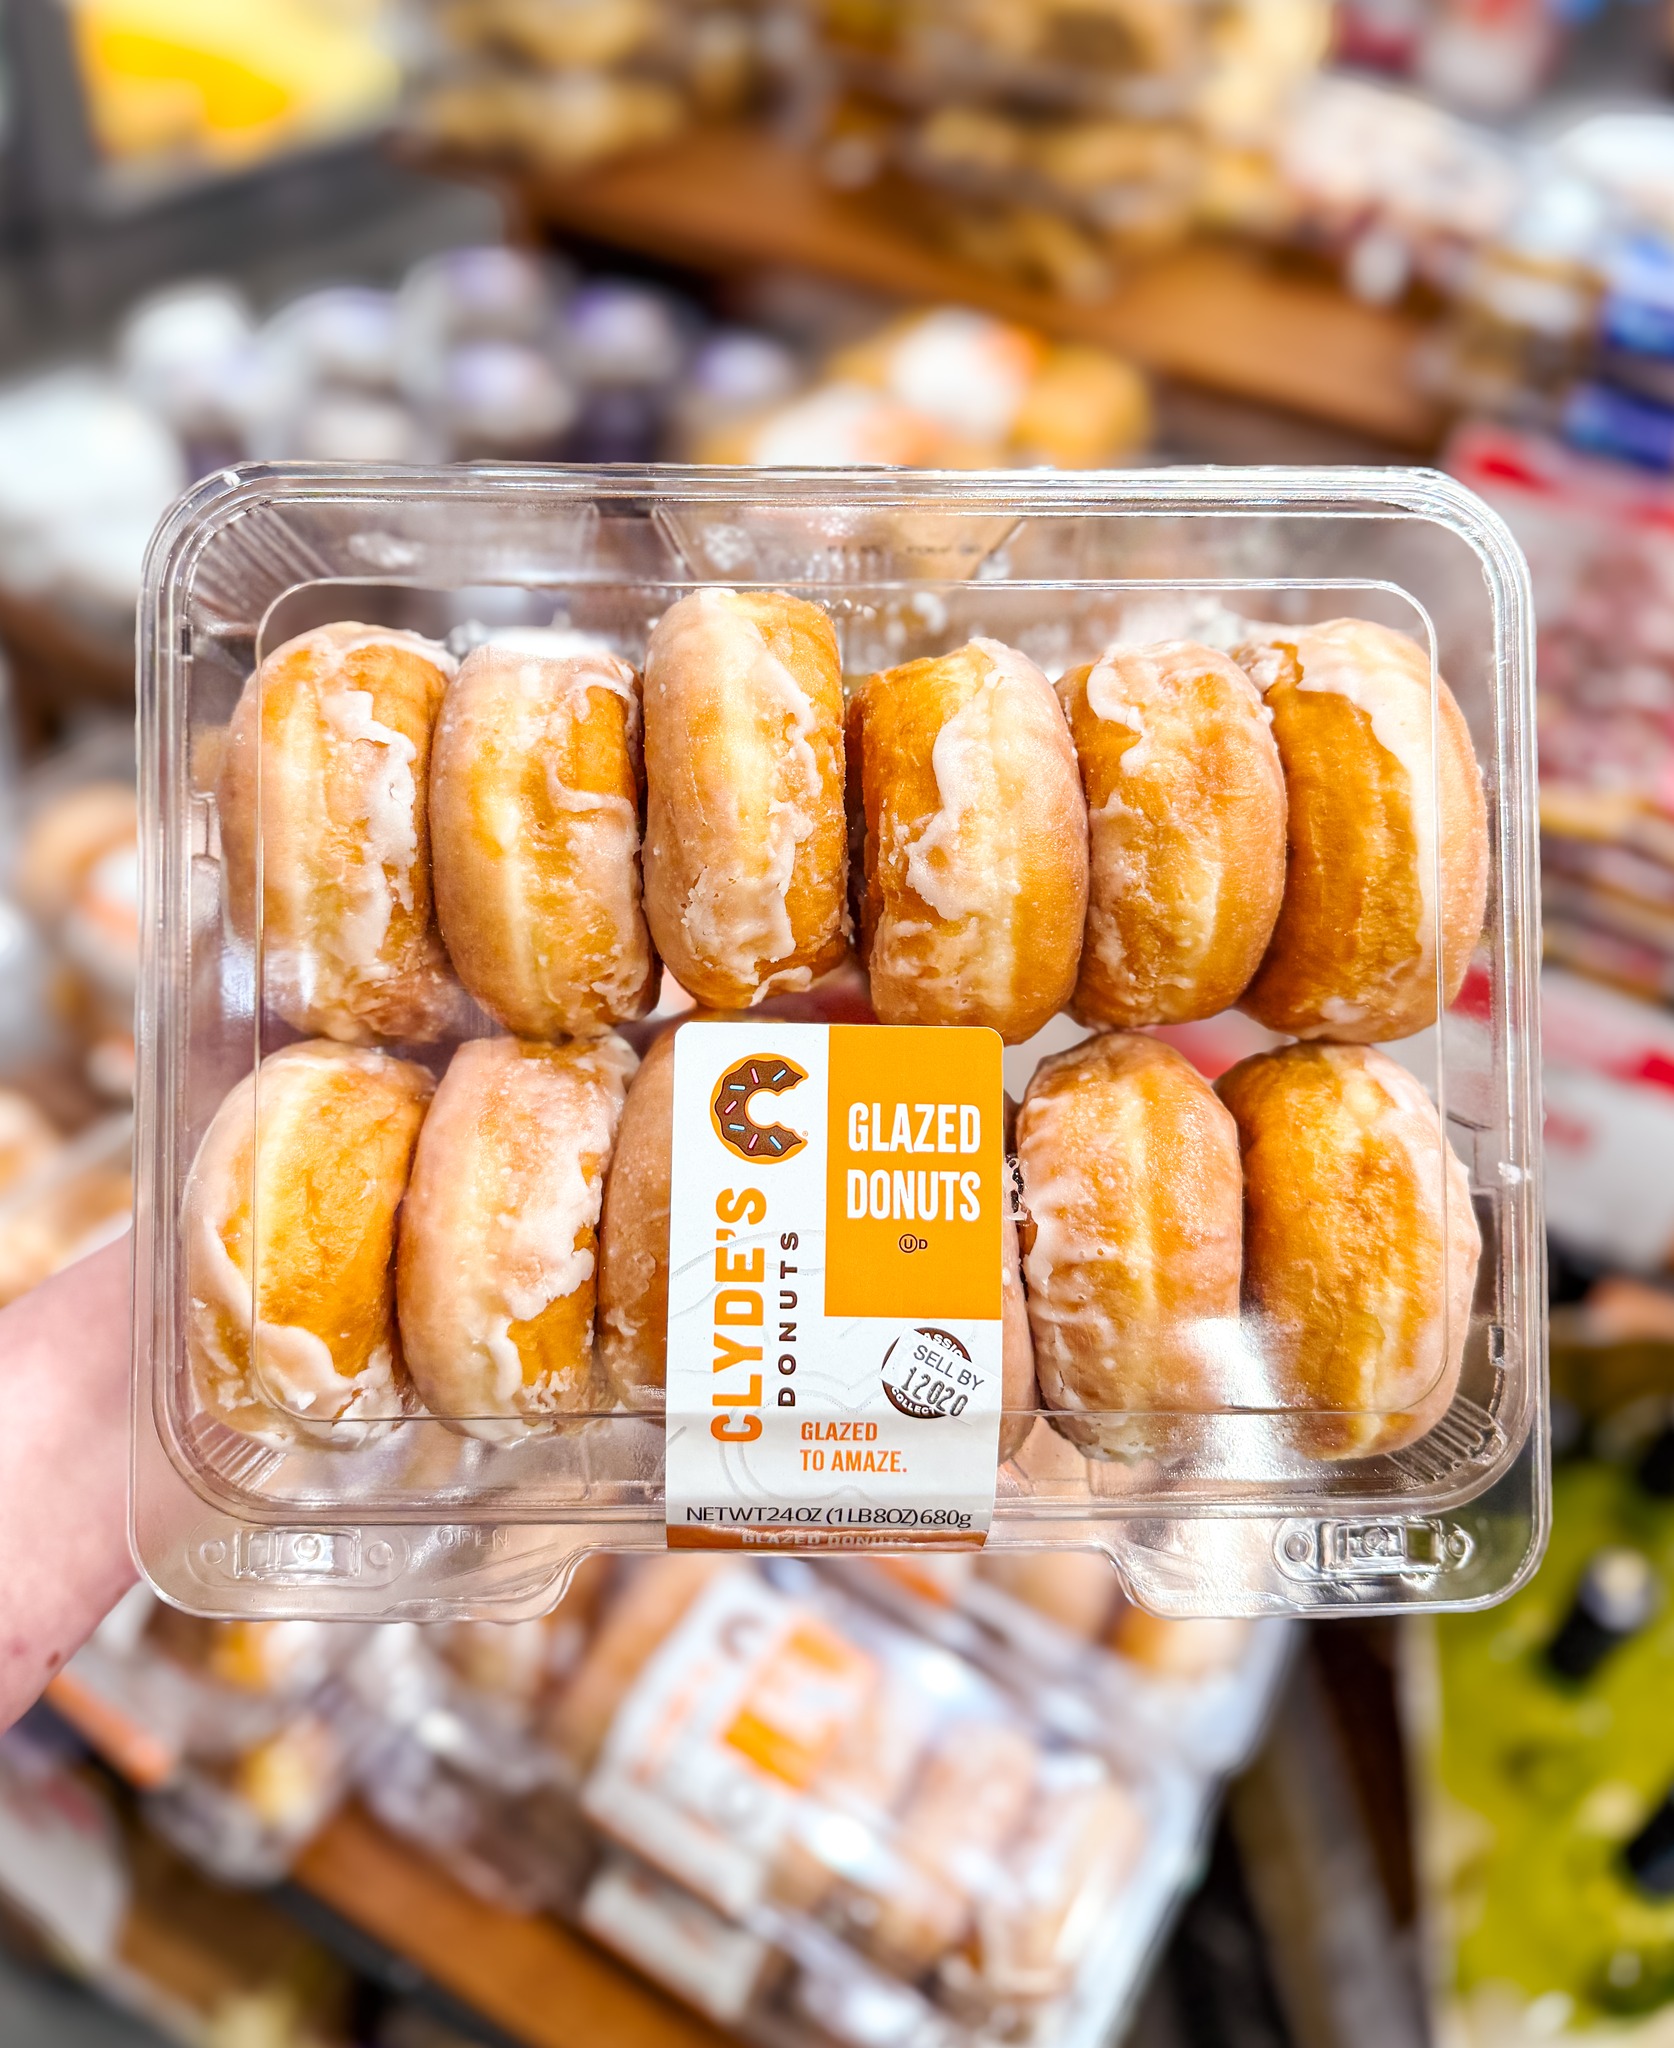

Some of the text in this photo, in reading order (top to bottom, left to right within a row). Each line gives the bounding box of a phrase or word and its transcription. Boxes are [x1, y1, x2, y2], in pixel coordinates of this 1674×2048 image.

[848, 1102, 981, 1154] GLAZED
[847, 1169, 981, 1221] DONUTS
[711, 1187, 767, 1442] CLYDE'S
[778, 1232, 799, 1407] DONUTS
[901, 1366, 968, 1416] 12020
[913, 1344, 984, 1391] SELL BY
[891, 1387, 935, 1415] COLLECT
[801, 1421, 878, 1441] GLAZED
[800, 1450, 907, 1472] TO AMAZE.
[438, 1528, 508, 1549] OPEN
[742, 1533, 911, 1547] GLAZED DONUTS
